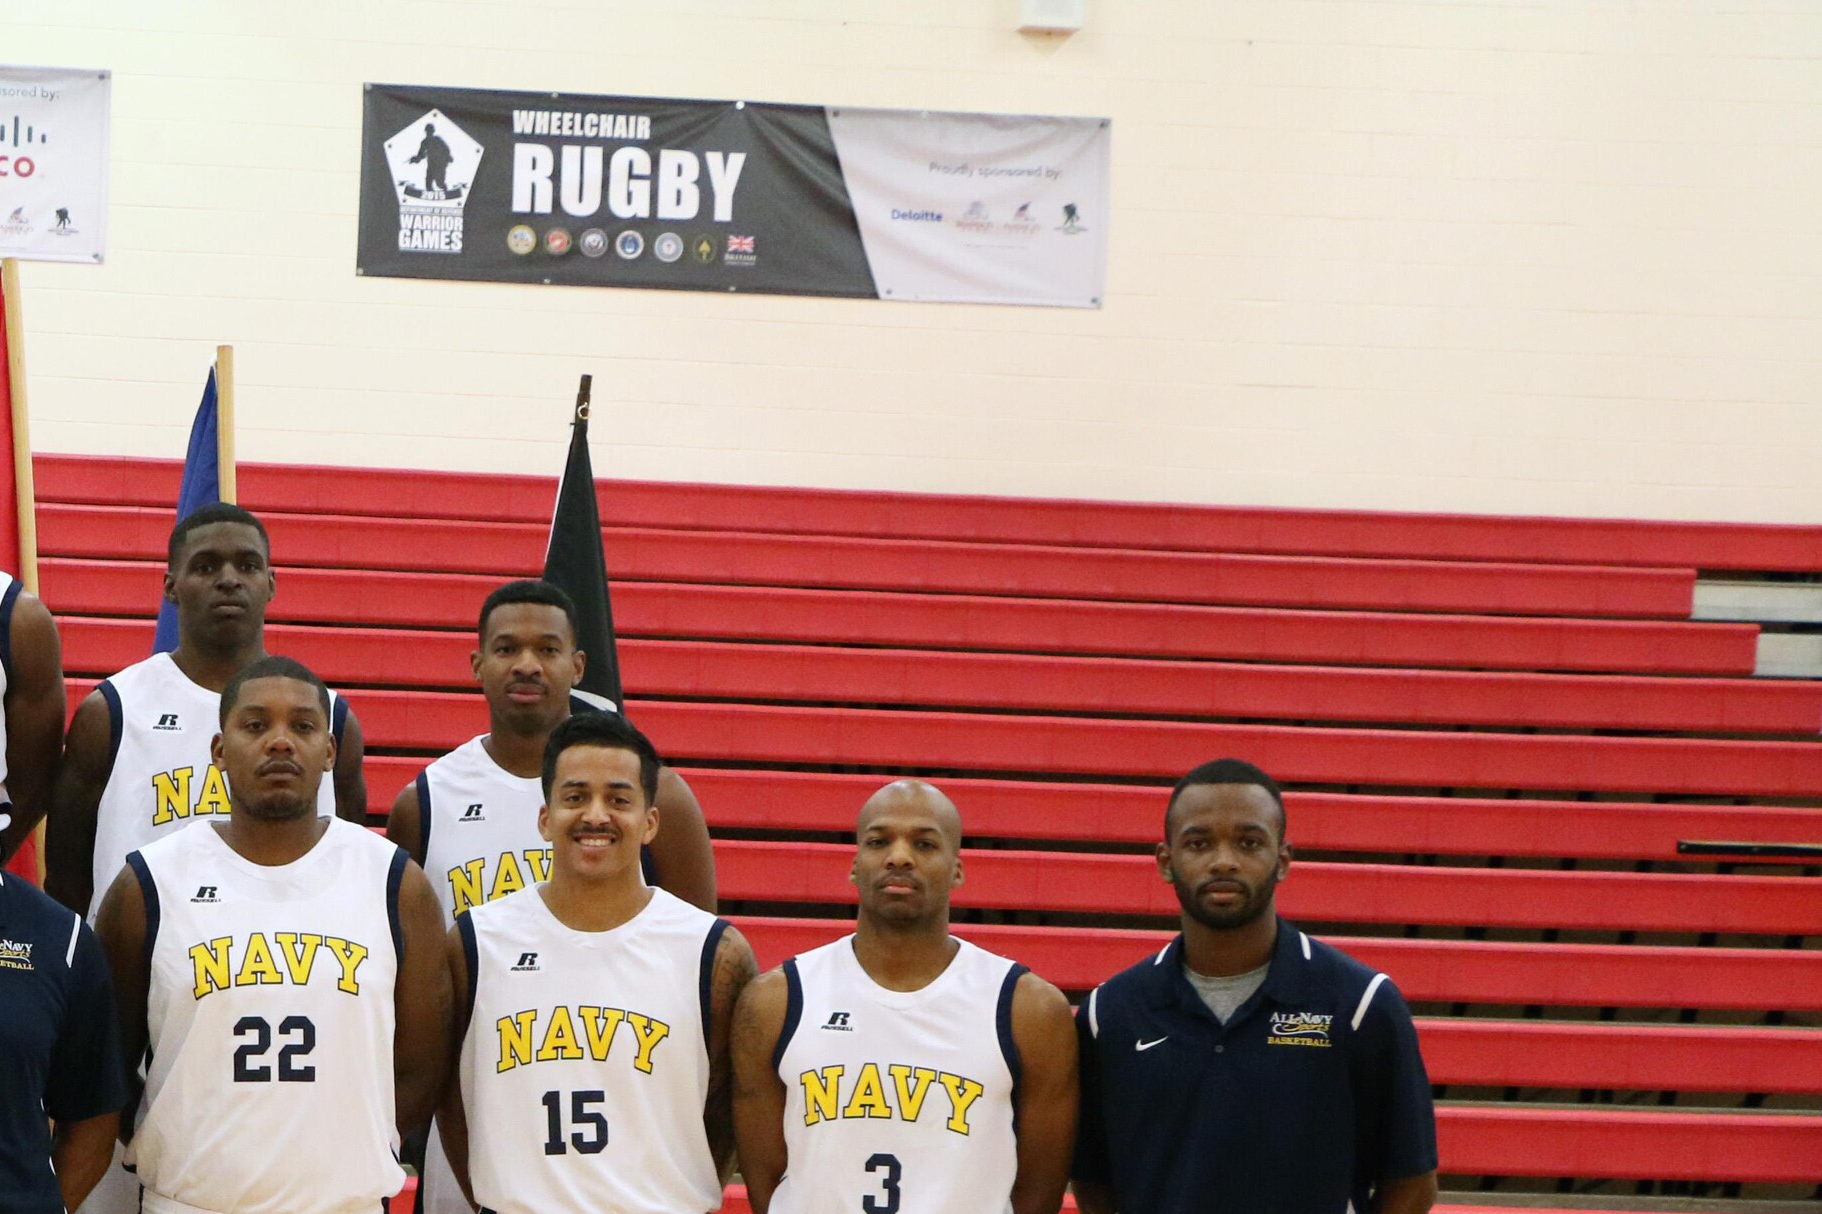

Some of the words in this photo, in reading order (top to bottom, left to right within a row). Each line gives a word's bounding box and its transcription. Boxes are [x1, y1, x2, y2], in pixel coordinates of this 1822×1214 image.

[512, 109, 651, 141] WHEELCHAIR
[511, 142, 747, 222] RUGBY
[400, 213, 464, 231] WARRIOR
[891, 208, 943, 222] Deloitte
[398, 228, 464, 251] GAMES
[152, 764, 232, 827] NA
[464, 803, 483, 817] R
[196, 886, 218, 898] R
[188, 932, 369, 1000] NAVY
[517, 952, 538, 966] R
[827, 1012, 850, 1026] R
[233, 1016, 316, 1082] 22
[496, 1005, 669, 1074] NAVY
[1267, 1036, 1332, 1047] BASKETBALL
[800, 1063, 983, 1136] NAVY
[542, 1091, 609, 1155] 15
